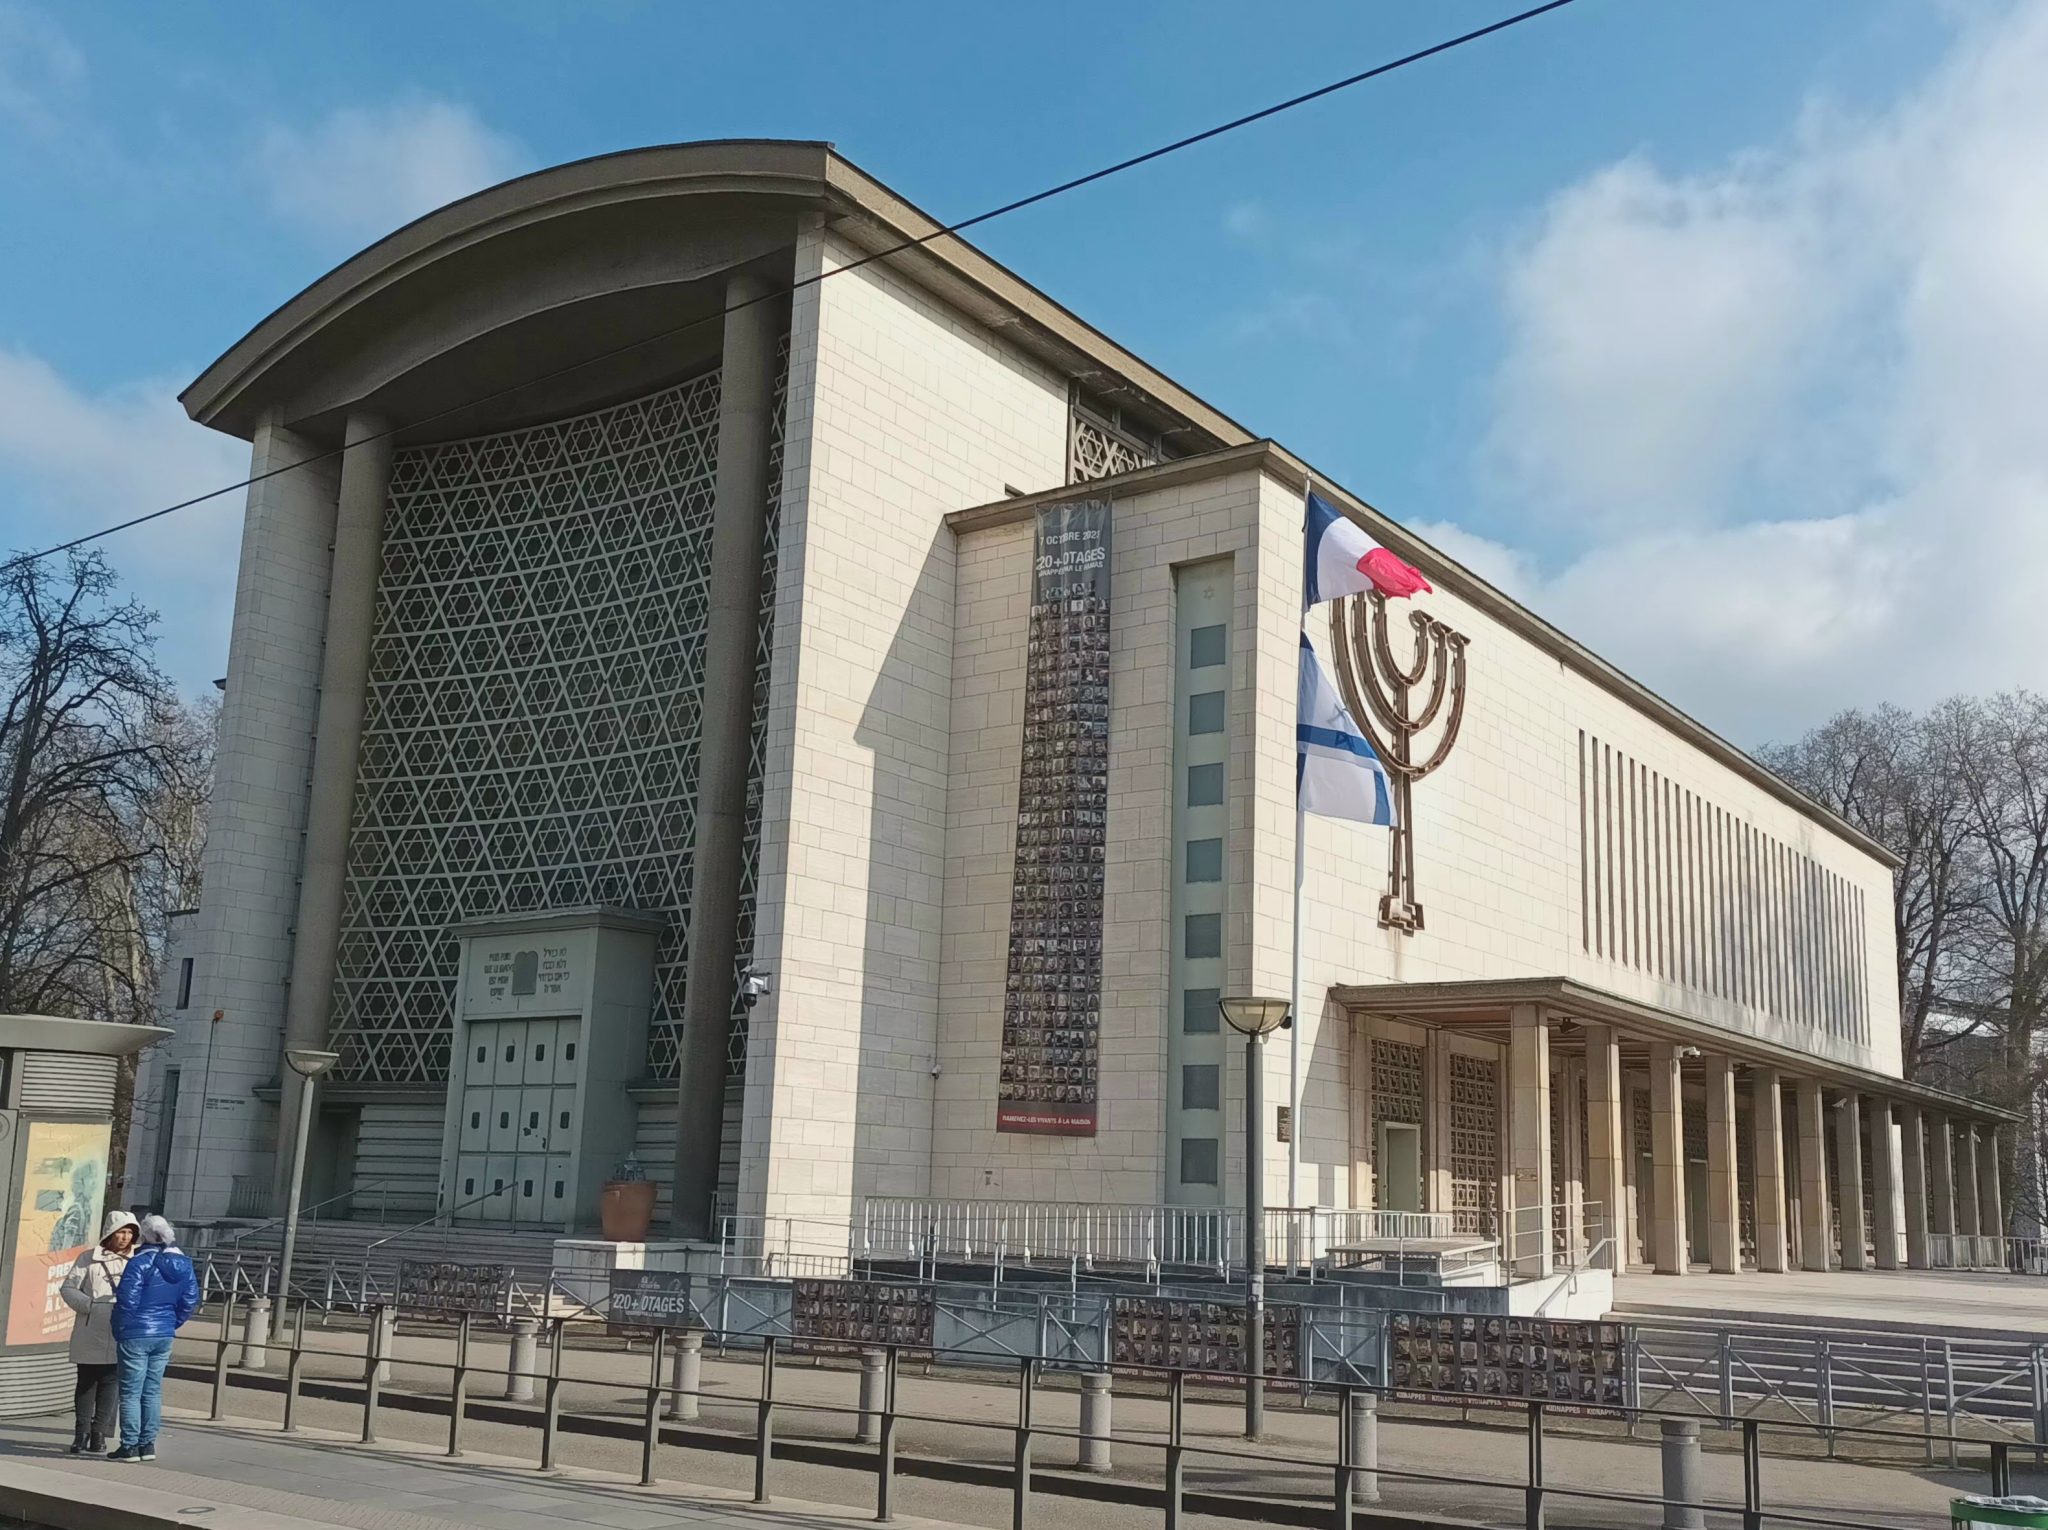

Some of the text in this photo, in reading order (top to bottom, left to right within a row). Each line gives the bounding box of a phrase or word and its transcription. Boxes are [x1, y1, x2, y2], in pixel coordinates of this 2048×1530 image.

[1063, 546, 1106, 565] OTAGES
[612, 1292, 639, 1311] 220+
[641, 1295, 685, 1314] OTAGES
